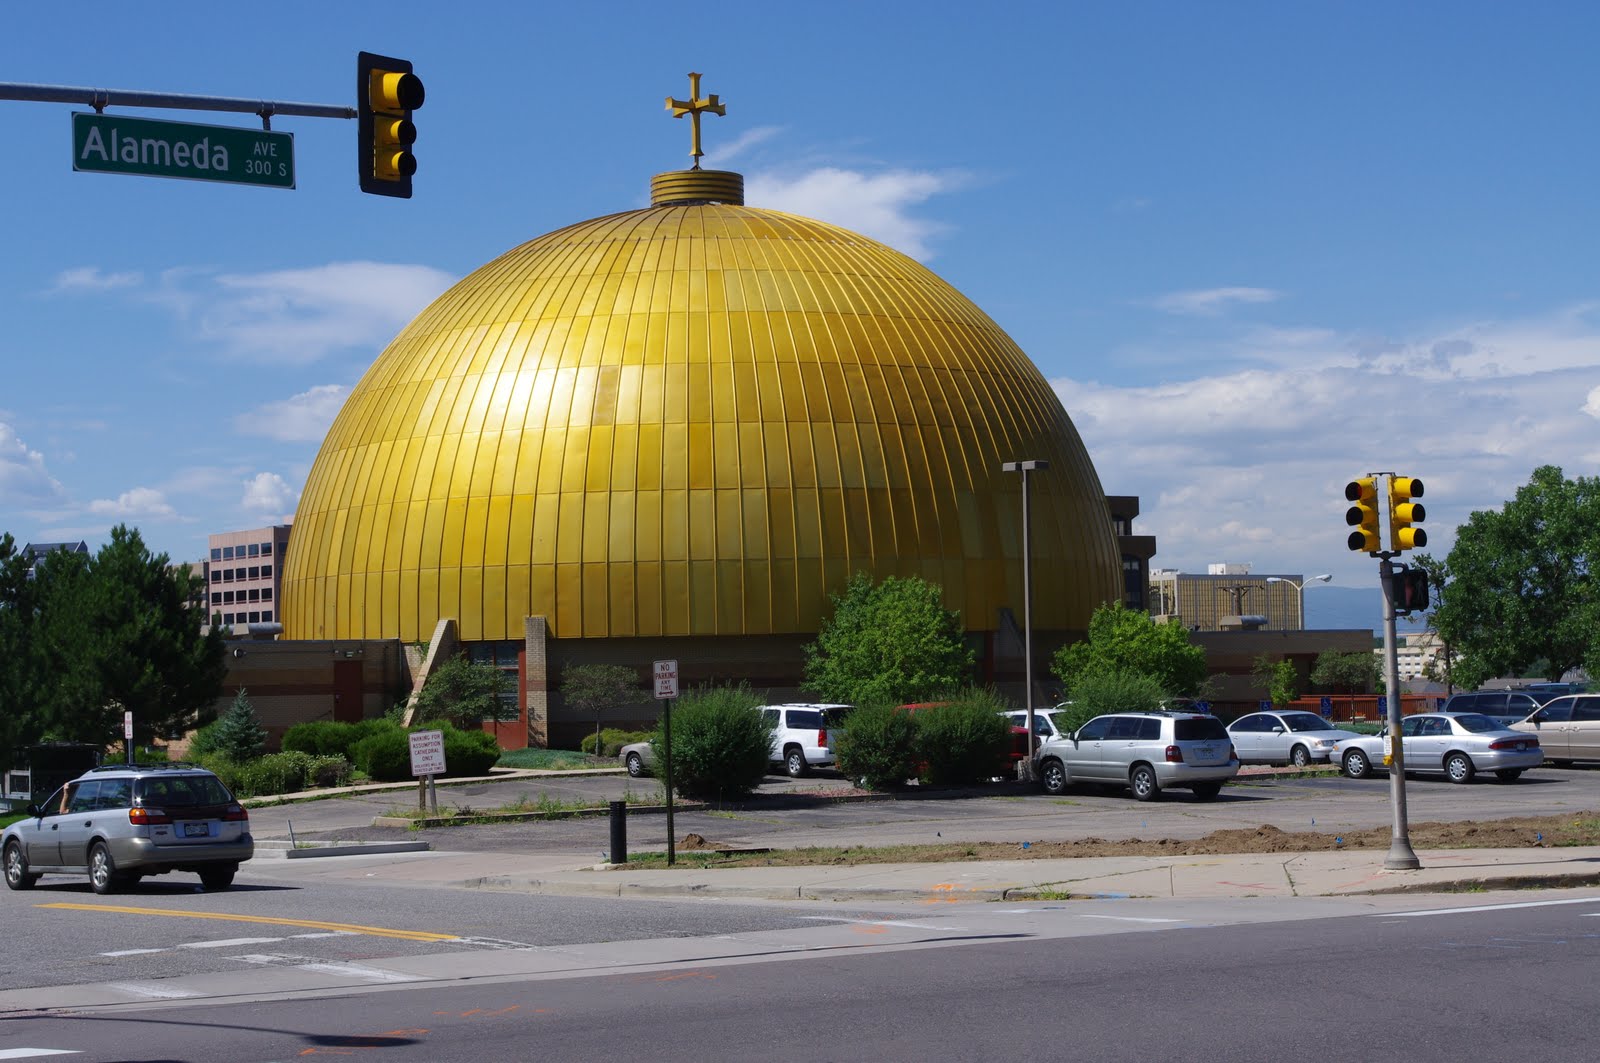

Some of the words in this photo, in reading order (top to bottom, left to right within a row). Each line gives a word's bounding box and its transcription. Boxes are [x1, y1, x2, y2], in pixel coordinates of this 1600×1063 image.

[81, 125, 229, 171] Alameda
[253, 141, 277, 157] AVE
[245, 159, 272, 176] 300
[278, 162, 287, 177] S
[655, 672, 676, 680] PARKING
